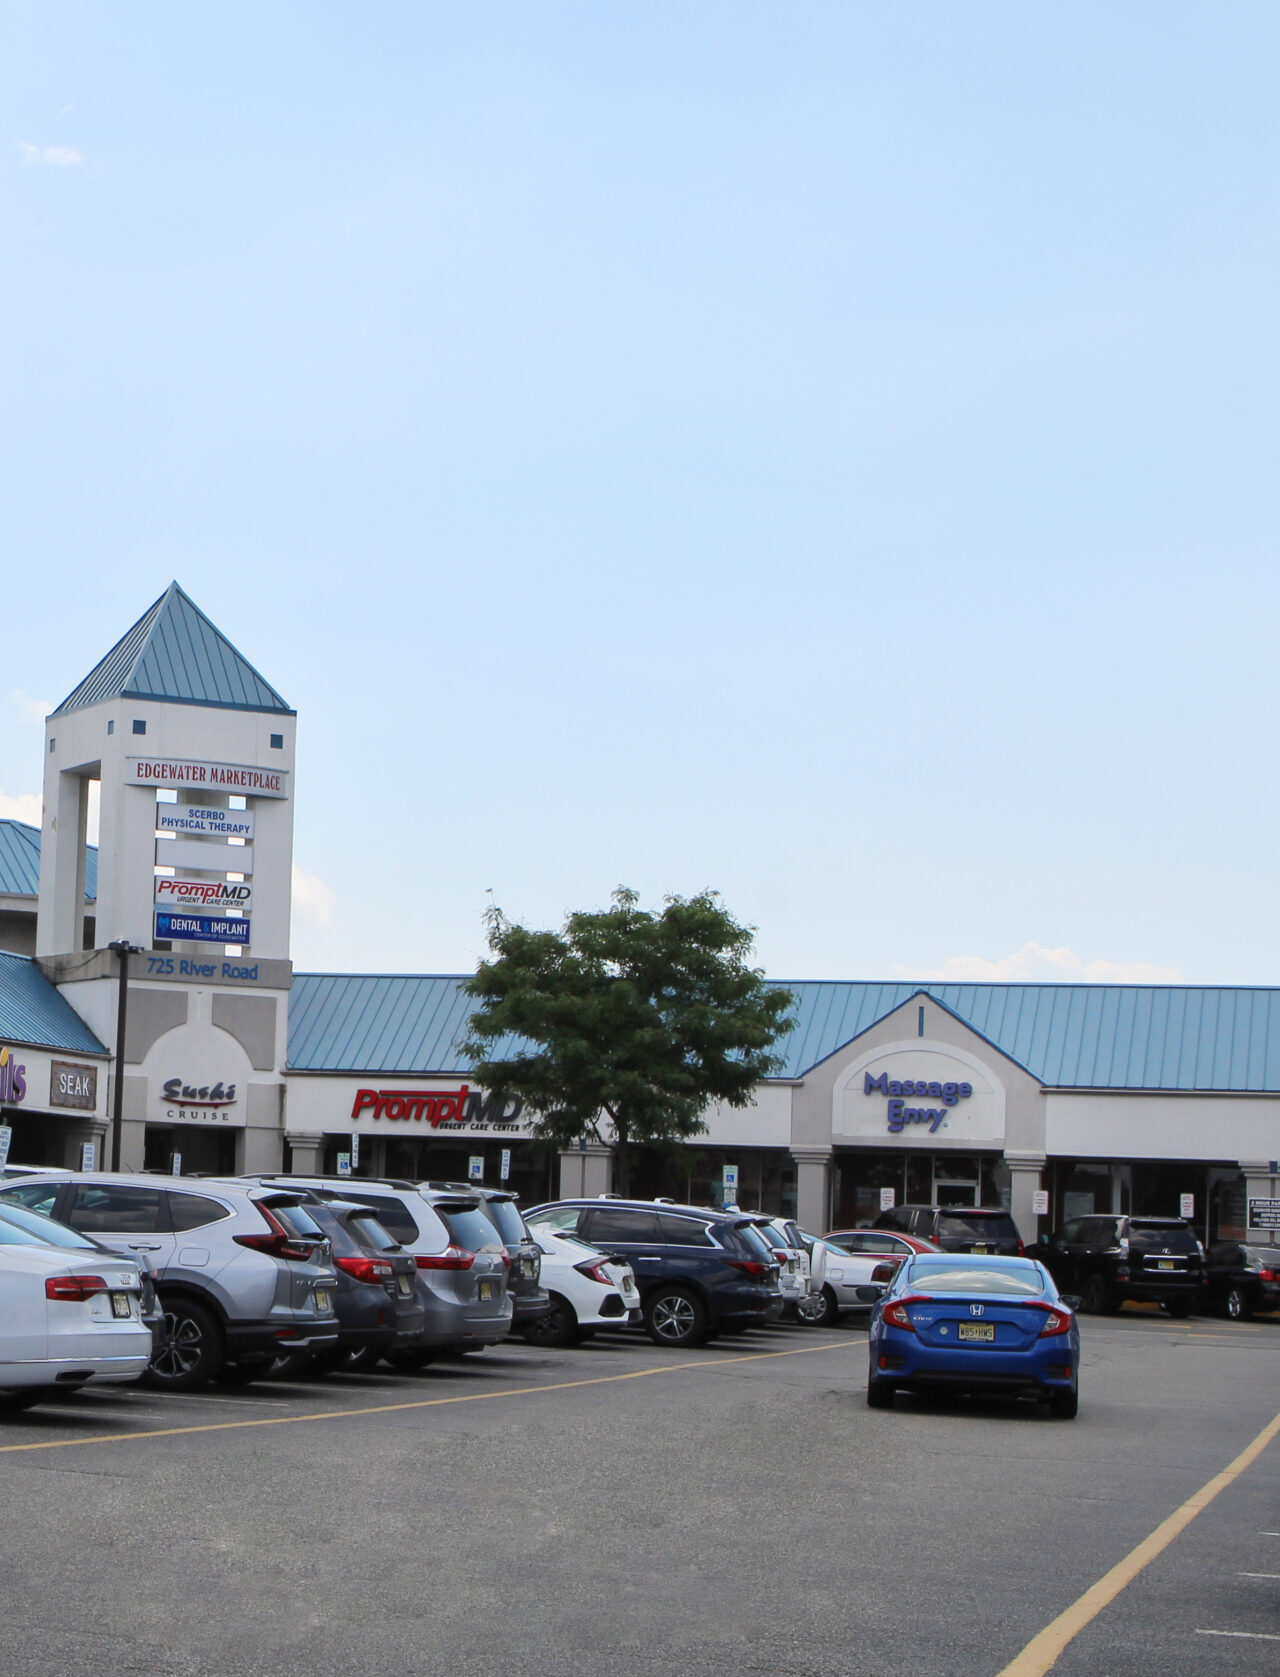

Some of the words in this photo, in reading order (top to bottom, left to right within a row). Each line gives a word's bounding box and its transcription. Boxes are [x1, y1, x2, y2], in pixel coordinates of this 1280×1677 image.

[137, 763, 206, 781] EDGEWATER
[210, 768, 280, 790] MARKETPLACE
[161, 817, 205, 830] PHYSICAL
[209, 822, 250, 833] THERAPY
[189, 809, 225, 820] SCERBO
[158, 881, 251, 904] PromptMD
[171, 919, 201, 931] DENTAL
[211, 922, 248, 935] IMPLANT
[147, 958, 174, 974] 725
[180, 960, 217, 977] River
[222, 963, 258, 979] Road
[60, 1073, 89, 1097] SEAK
[163, 1078, 236, 1101] Sushi
[864, 1071, 972, 1106] Massage
[167, 1110, 229, 1121] CRUISE
[351, 1084, 523, 1128] PromptMD
[888, 1099, 947, 1133] Envy
[470, 1123, 488, 1131] CARE
[493, 1124, 519, 1132] CENTER
